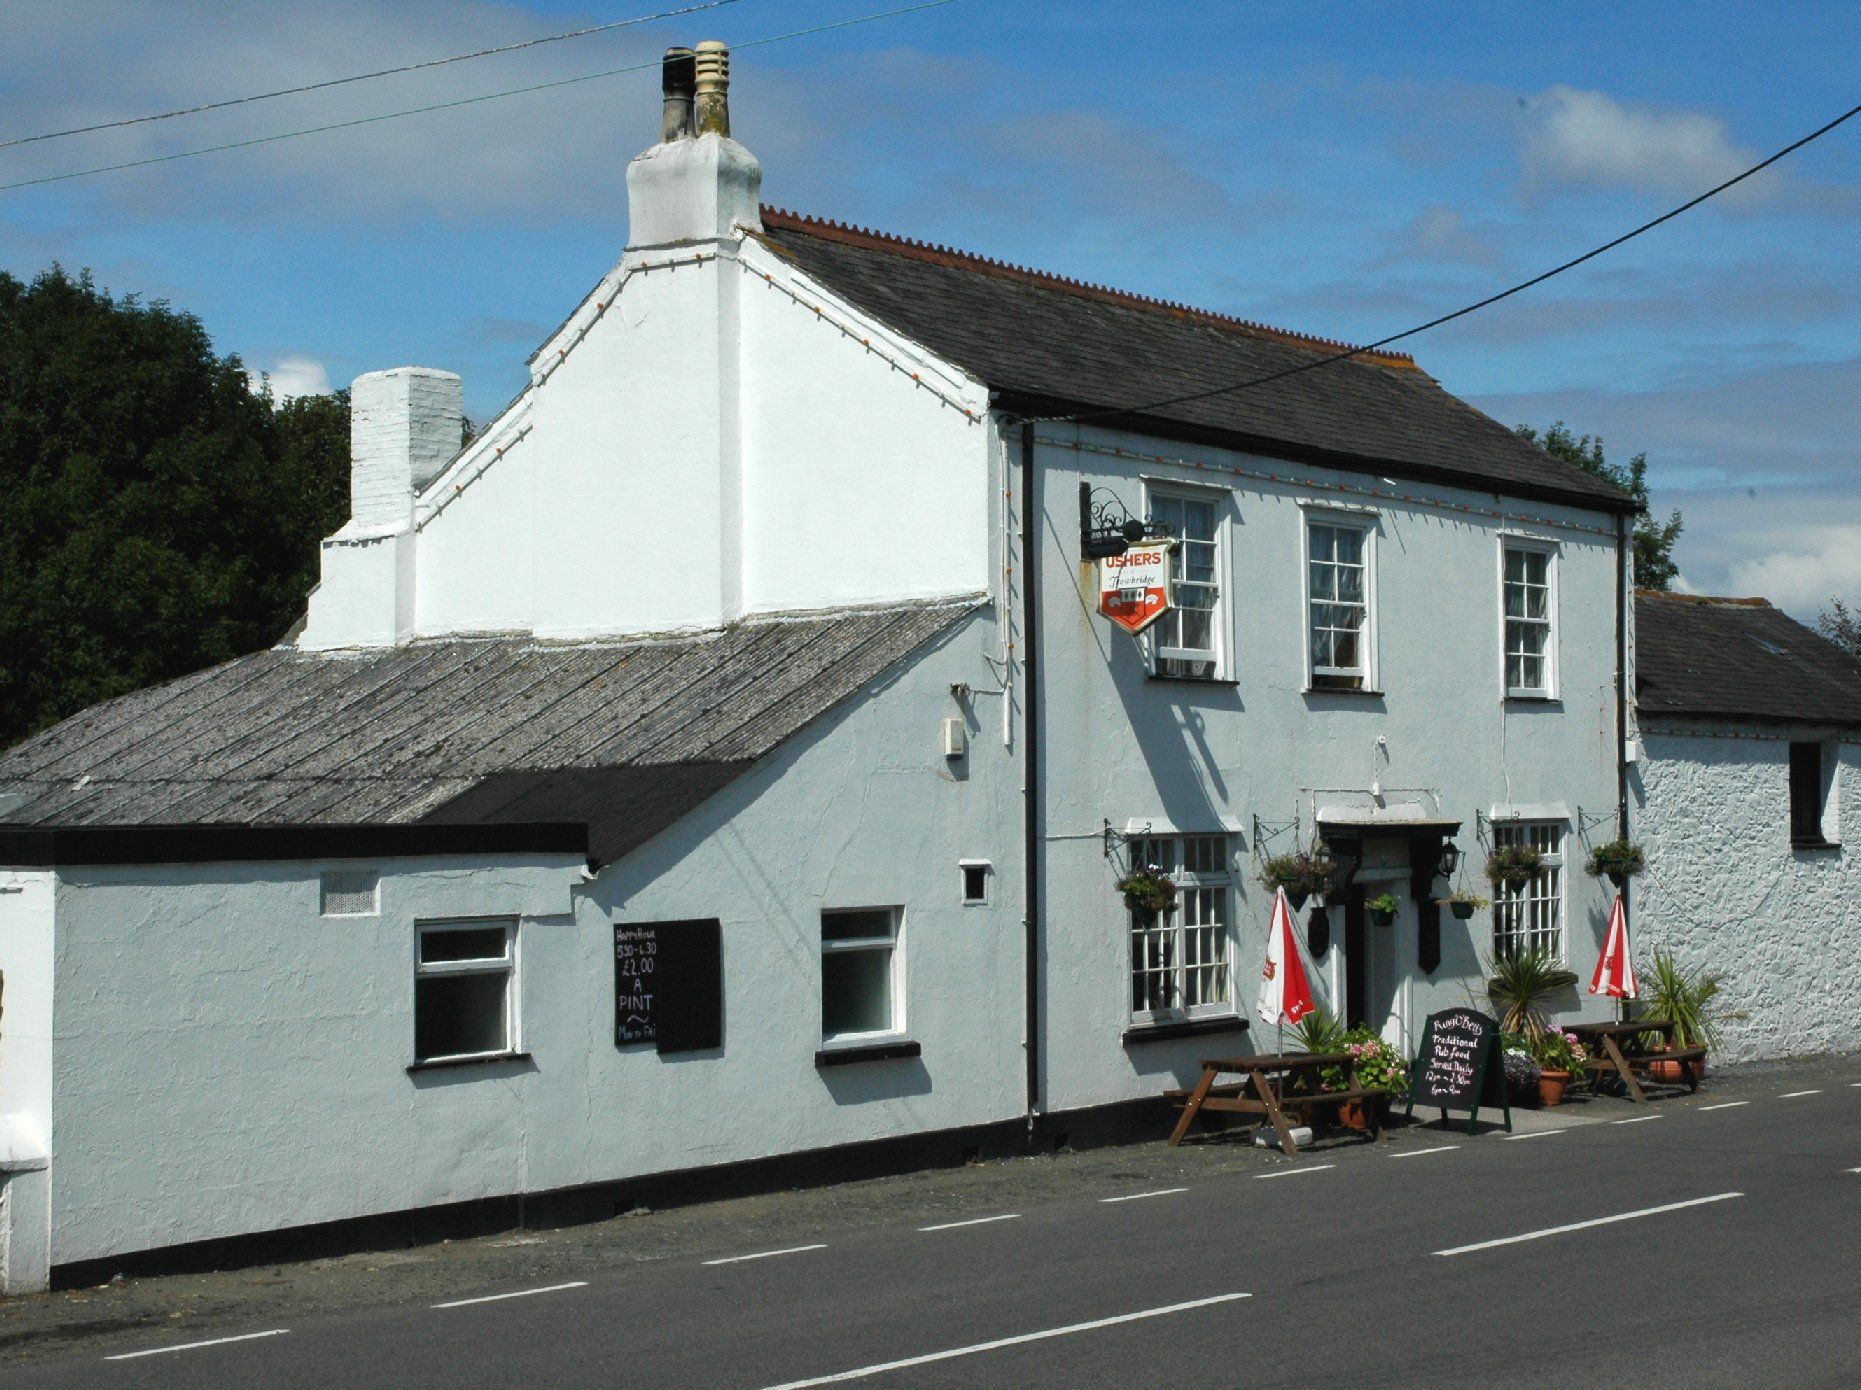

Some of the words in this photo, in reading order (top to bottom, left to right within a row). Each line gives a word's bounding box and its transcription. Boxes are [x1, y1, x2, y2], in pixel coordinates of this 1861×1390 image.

[1106, 552, 1161, 568] USHERS
[633, 978, 642, 992] A
[619, 994, 653, 1010] PINT
[1432, 1034, 1478, 1048] Traditional
[1435, 1045, 1449, 1057] Pub
